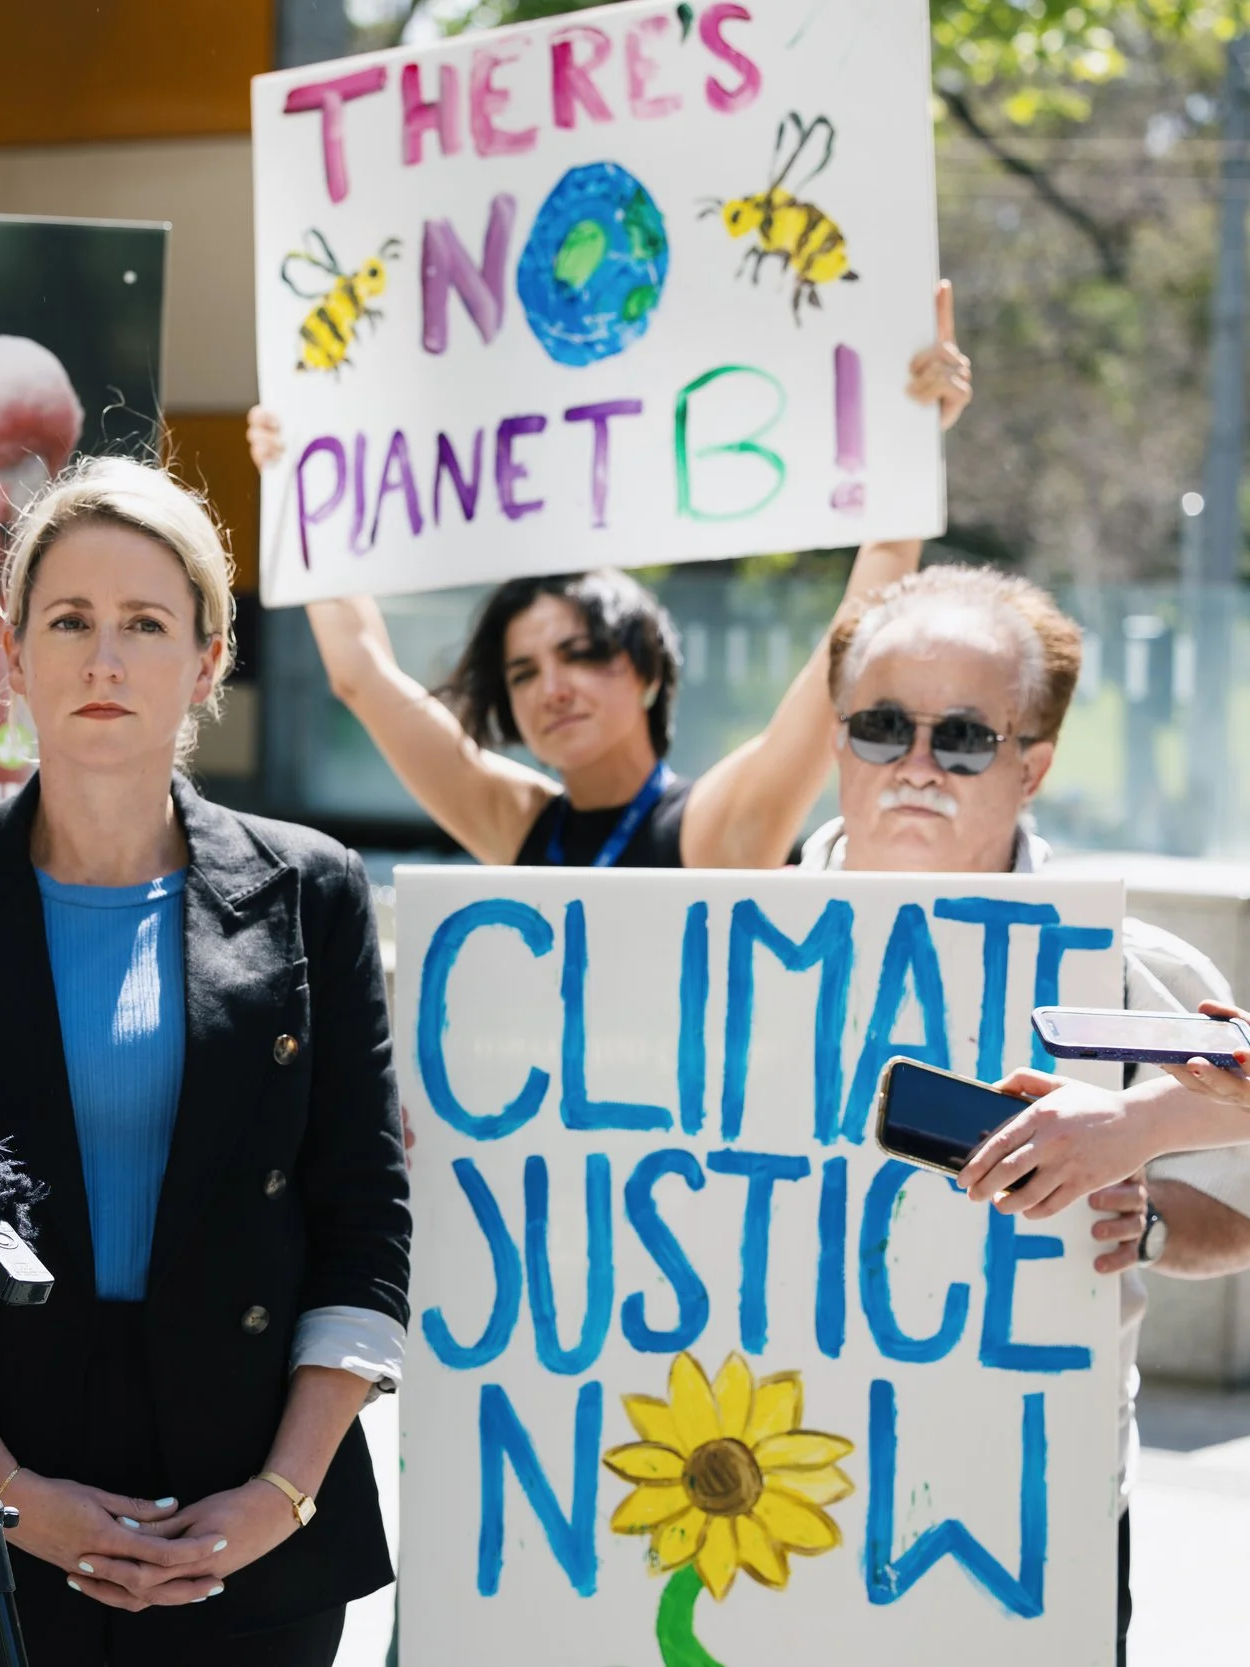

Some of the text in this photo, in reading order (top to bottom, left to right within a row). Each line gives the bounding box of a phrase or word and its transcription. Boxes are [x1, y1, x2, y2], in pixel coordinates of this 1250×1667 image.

[283, 3, 762, 204] THERE'S
[296, 398, 643, 571] PLANET
[422, 1147, 1094, 1375] JUSTICE
